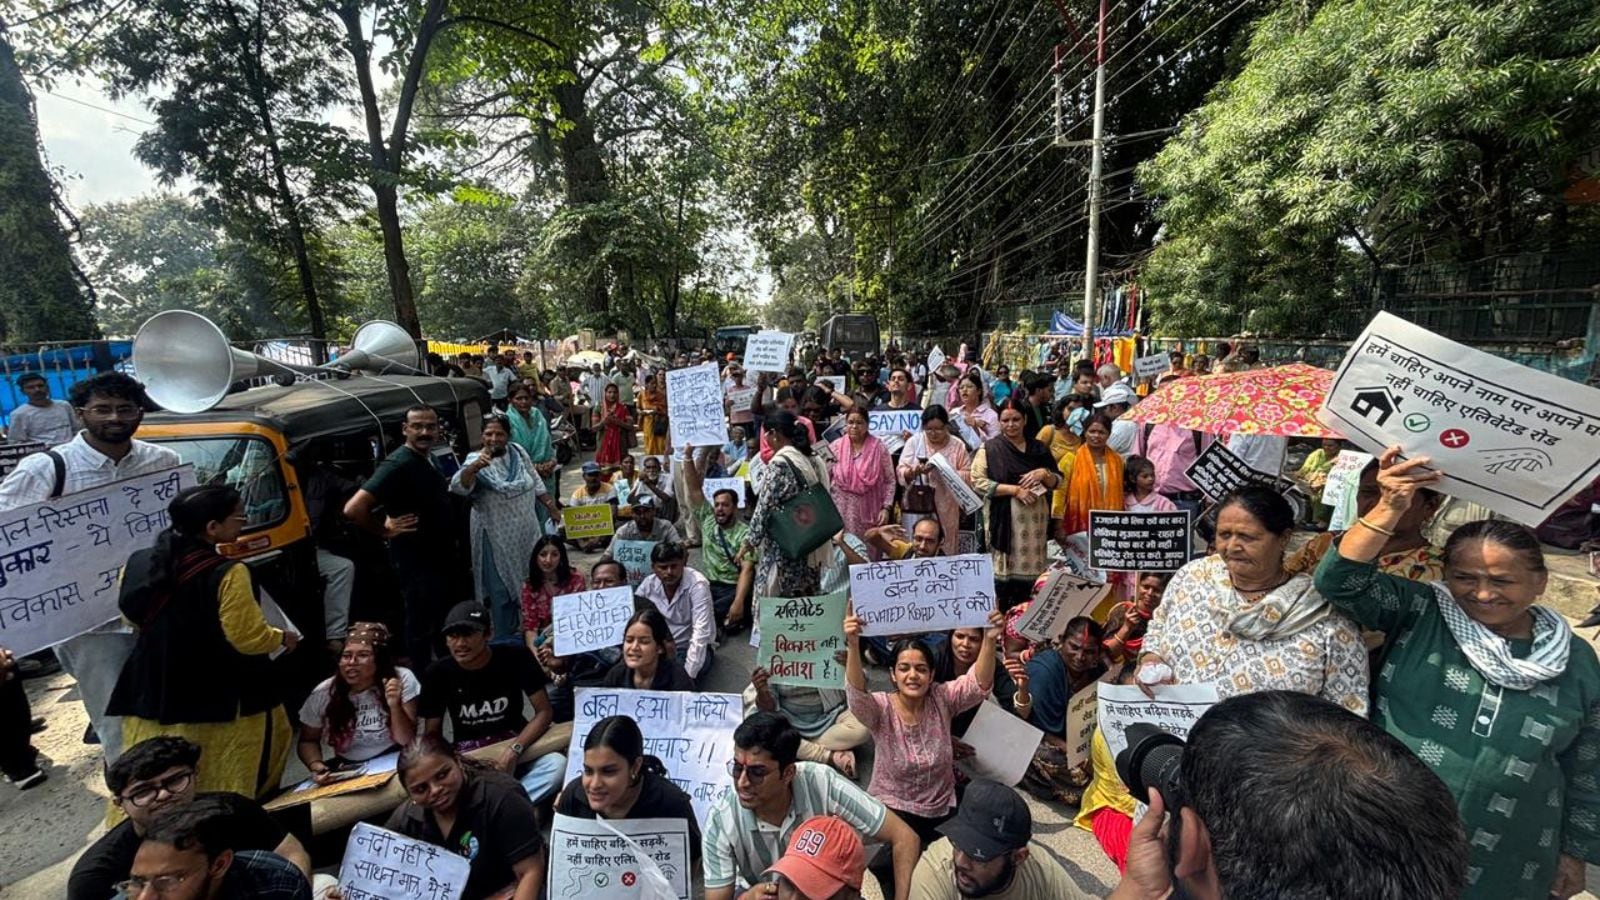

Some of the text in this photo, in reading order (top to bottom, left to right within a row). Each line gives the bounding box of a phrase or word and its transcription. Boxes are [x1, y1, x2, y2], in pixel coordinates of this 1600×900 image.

[1365, 342, 1600, 437] हमें चाहिए अपने नाम पर अपने घ
[869, 412, 920, 430] SAY NO
[1385, 372, 1562, 447] नहीं चाहिए एलिवेटेड रोड
[122, 486, 143, 508] दे
[153, 471, 181, 505] रही
[87, 523, 112, 547] ये
[124, 507, 171, 538] विना
[914, 560, 938, 580] की
[947, 558, 985, 577] हत्या
[925, 574, 959, 595] करो
[578, 592, 606, 611] NO
[907, 602, 936, 621] ROAD
[966, 591, 992, 612] करो
[557, 605, 632, 634] ELEVATED
[573, 625, 615, 648] ROAD
[774, 633, 816, 653] विकास
[769, 655, 816, 680] विनाश
[459, 696, 508, 718] MAD
[635, 695, 670, 723] हुआ
[1116, 704, 1143, 718] चाहिए
[356, 831, 396, 858] नदी
[566, 836, 579, 849] हमें
[581, 837, 607, 850] चाहिए
[795, 828, 826, 857] 89
[584, 853, 611, 867] चाहिए
[654, 851, 671, 861] रोड
[354, 860, 400, 887] साधन
